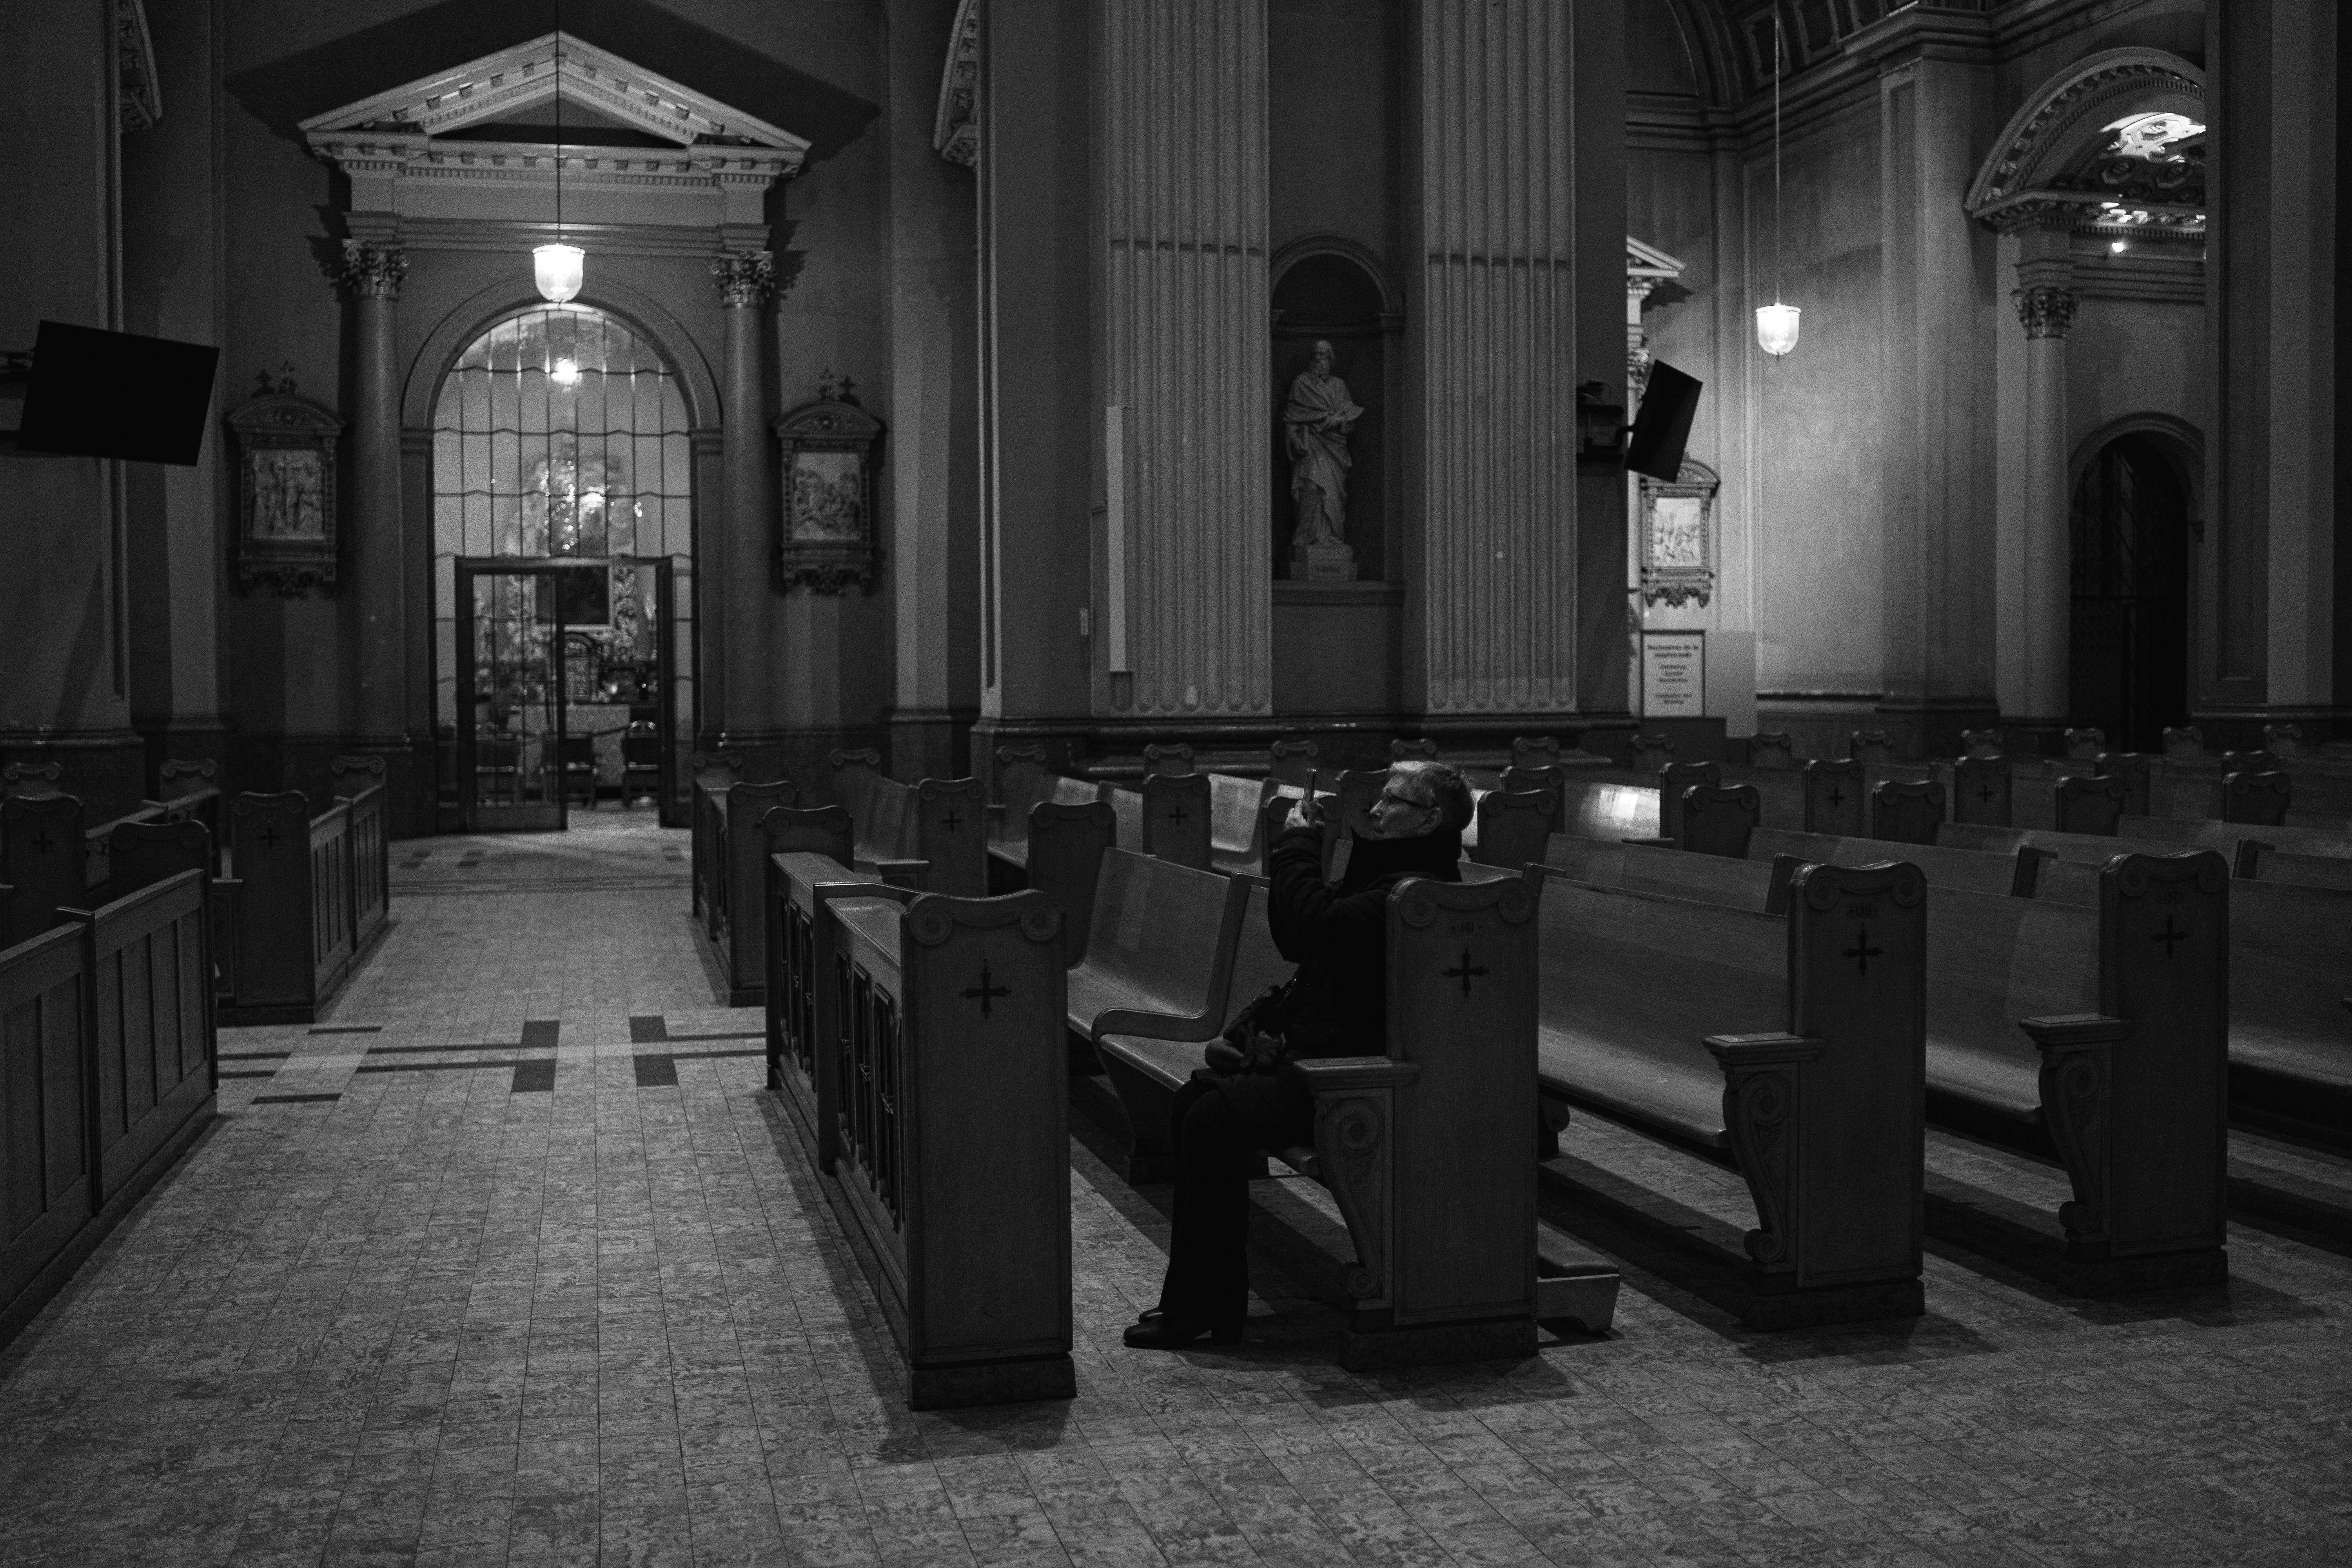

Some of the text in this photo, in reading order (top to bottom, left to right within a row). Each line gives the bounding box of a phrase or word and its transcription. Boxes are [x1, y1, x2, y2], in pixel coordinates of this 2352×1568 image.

[2164, 891, 2178, 902] 137
[1855, 905, 1871, 916] 139
[1461, 921, 1474, 933] 141
